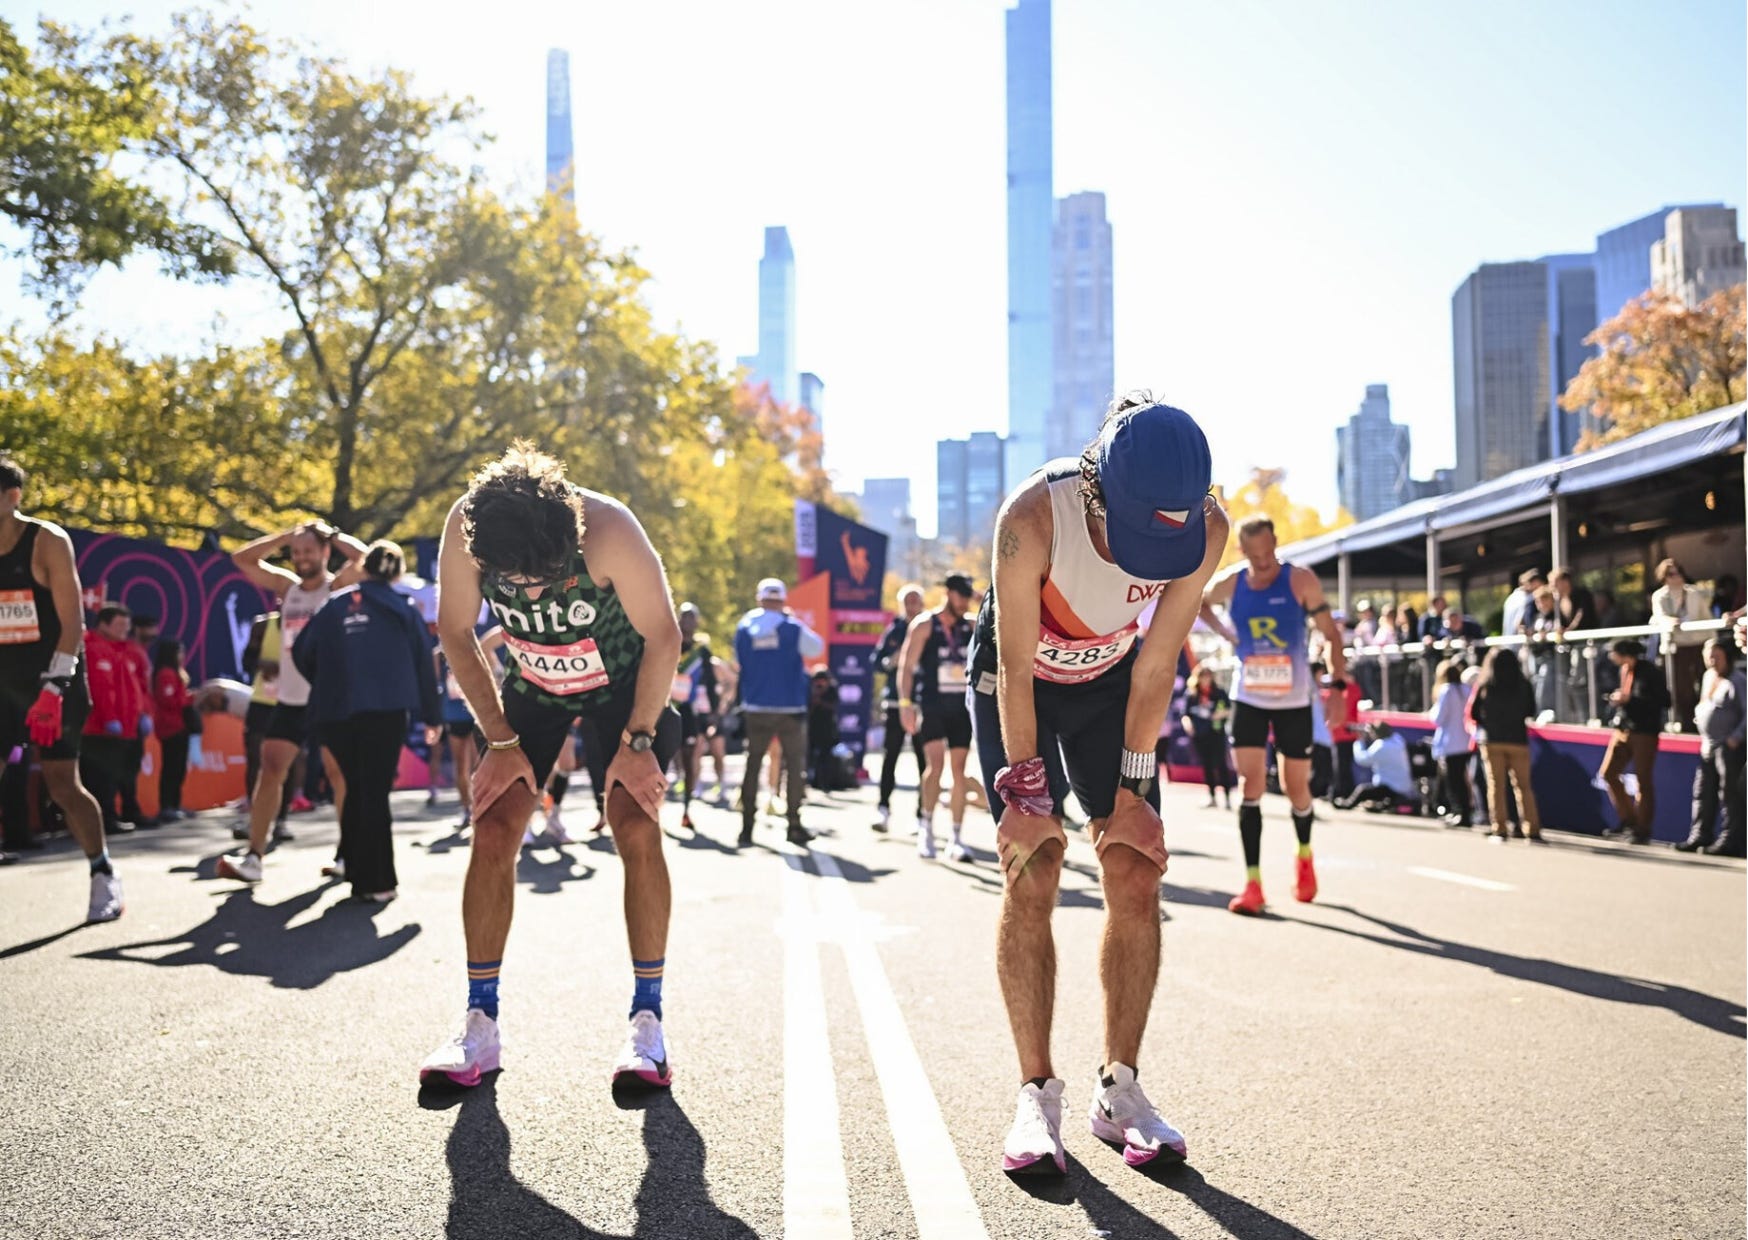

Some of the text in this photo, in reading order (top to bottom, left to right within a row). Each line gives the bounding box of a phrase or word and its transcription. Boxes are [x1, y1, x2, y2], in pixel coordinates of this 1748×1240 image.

[0, 604, 34, 620] 1765
[1248, 616, 1288, 648] R
[519, 652, 588, 673] 4440
[1040, 642, 1120, 665] 4283
